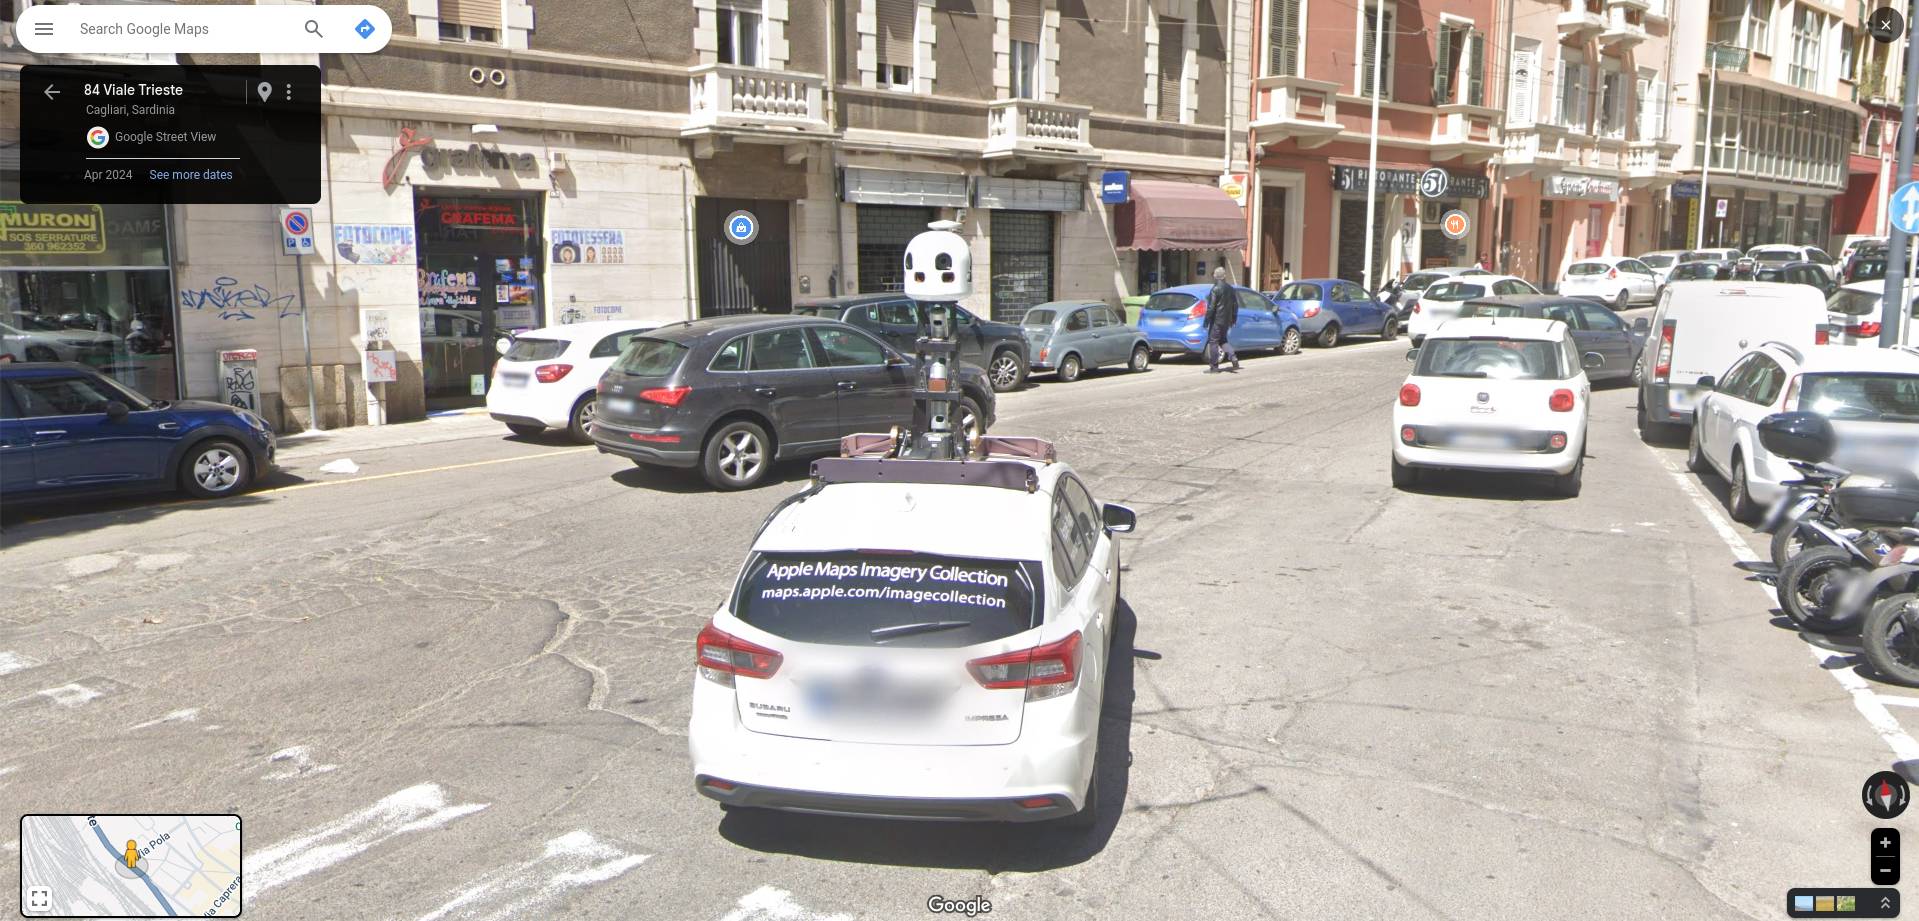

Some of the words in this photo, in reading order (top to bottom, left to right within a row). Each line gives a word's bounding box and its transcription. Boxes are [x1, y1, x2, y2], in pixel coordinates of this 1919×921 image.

[1358, 169, 1416, 184] RITORANTE
[4, 213, 96, 229] MURONI
[441, 211, 516, 225] GRAFEMA
[9, 233, 33, 242] SOS
[35, 233, 99, 242] SERRATURE
[335, 225, 414, 245] FOTOCOPIE
[551, 229, 625, 245] FOTOTESSERA
[766, 562, 813, 579] Apple
[814, 561, 858, 580] Maps
[860, 562, 928, 583] Imagery
[929, 565, 1008, 588] Collection
[762, 585, 1006, 609] maps.apple.com/imagecollection
[749, 702, 791, 713] SUBARU
